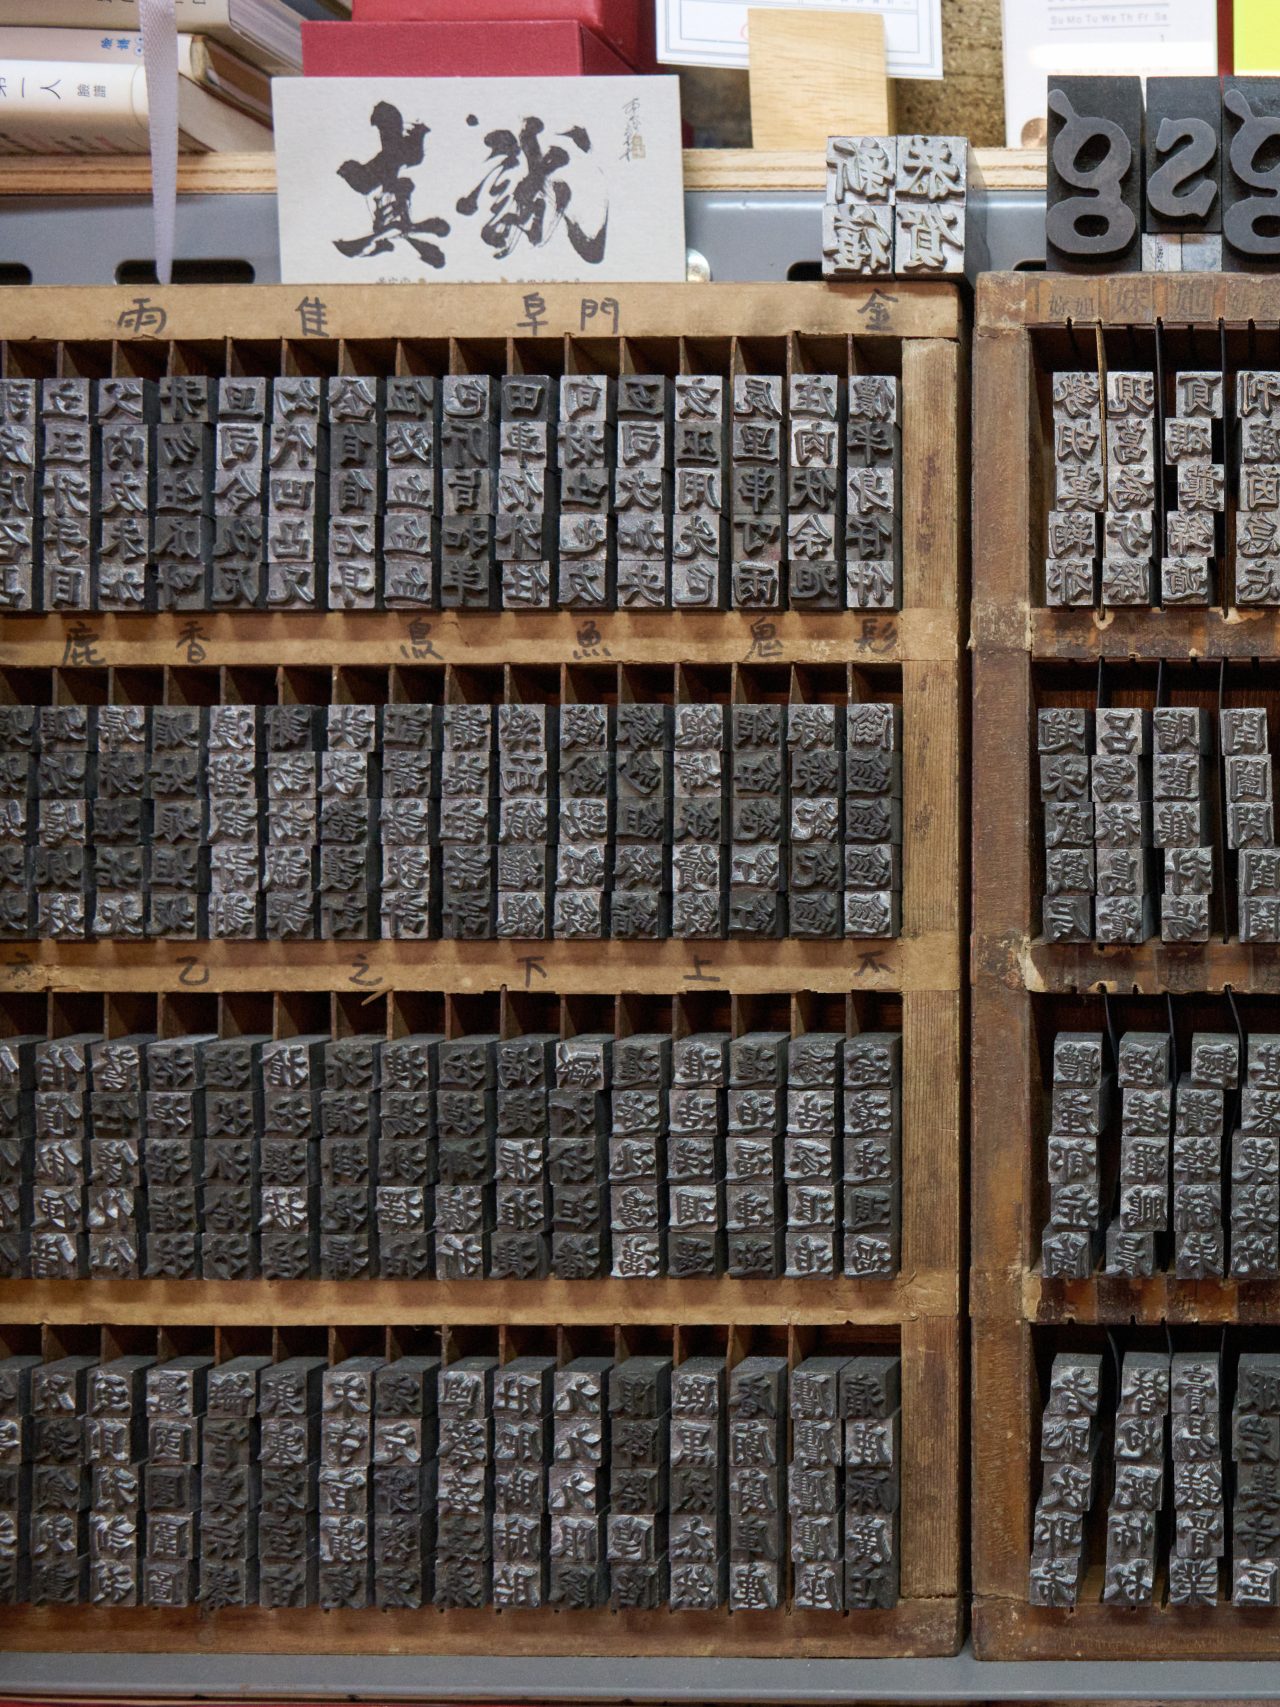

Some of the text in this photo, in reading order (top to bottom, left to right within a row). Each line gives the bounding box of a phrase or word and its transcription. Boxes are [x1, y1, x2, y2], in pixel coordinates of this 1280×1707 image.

[1051, 12, 1167, 25] Su Mo Tu We Th Fr Sa
[117, 298, 167, 333] 雨
[580, 297, 620, 334] 門
[858, 288, 898, 331] 金
[63, 621, 105, 667] 鹿
[176, 620, 210, 665] 香
[742, 617, 783, 662] 鬼
